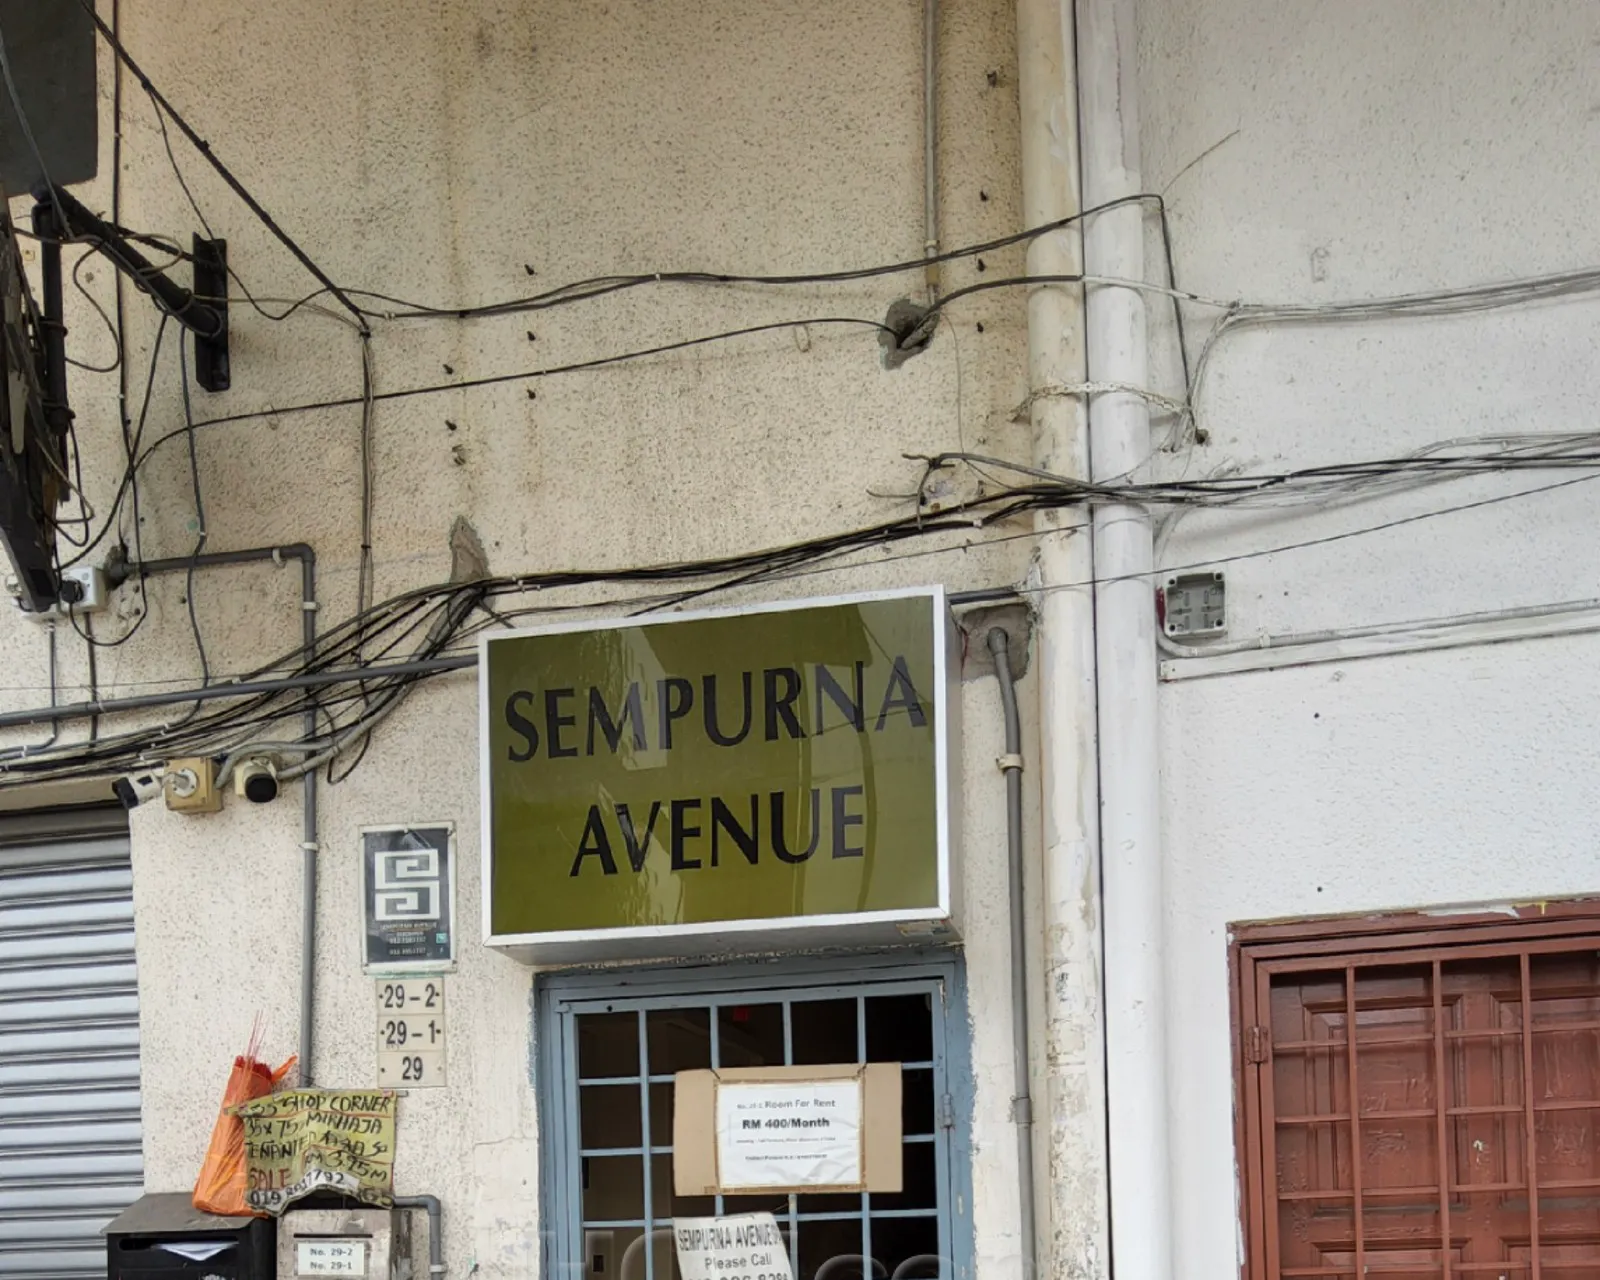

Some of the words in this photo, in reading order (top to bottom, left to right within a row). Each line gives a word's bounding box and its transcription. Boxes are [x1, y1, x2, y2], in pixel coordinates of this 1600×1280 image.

[504, 655, 928, 763] SEMPURNA
[569, 784, 864, 878] AVENUE
[402, 1056, 424, 1081] 29
[330, 1095, 391, 1114] CORNER
[813, 1098, 836, 1108] Rent
[742, 1118, 761, 1130] RM
[764, 1117, 831, 1129] 400/Month
[678, 1227, 732, 1252] SEMPURNA
[310, 1248, 326, 1257] No.
[331, 1248, 353, 1256] 29-2
[704, 1257, 747, 1270] Please
[750, 1252, 772, 1267] Call
[310, 1261, 326, 1270] No.
[331, 1261, 353, 1270] 29-1
